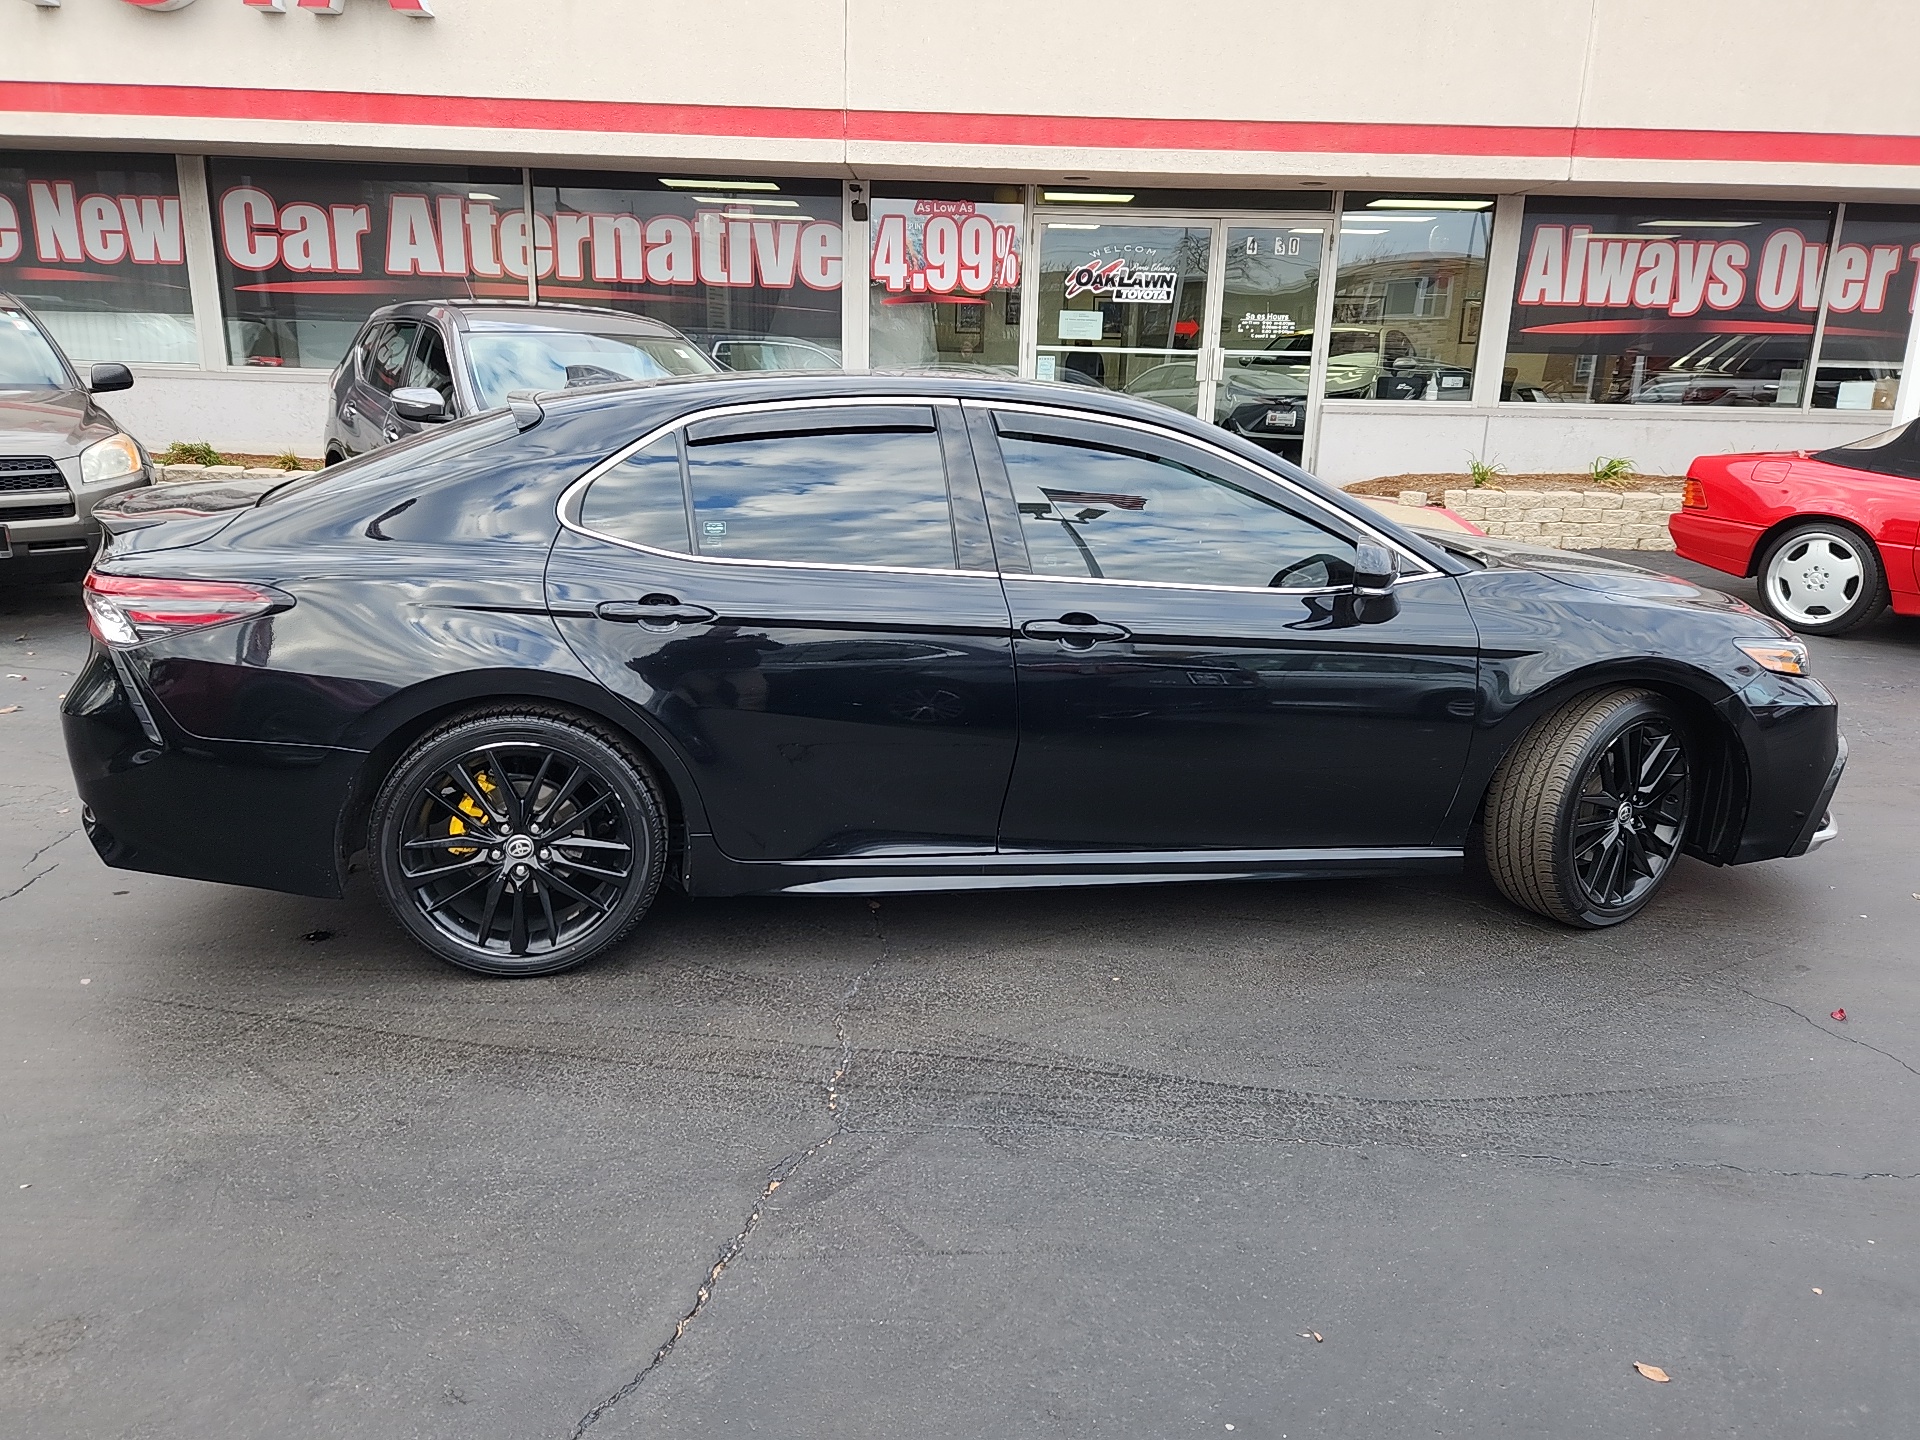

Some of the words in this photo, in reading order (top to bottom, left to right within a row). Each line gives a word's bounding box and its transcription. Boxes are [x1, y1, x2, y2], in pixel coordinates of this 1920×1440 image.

[916, 202, 931, 213] As
[933, 203, 956, 213] Low
[959, 203, 973, 213] As
[28, 180, 184, 264] New
[219, 185, 371, 273] Car
[385, 193, 843, 289] Alternative
[1119, 289, 1168, 301] TOYOTA
[1518, 224, 1750, 316] Always
[1755, 228, 1903, 313] Over
